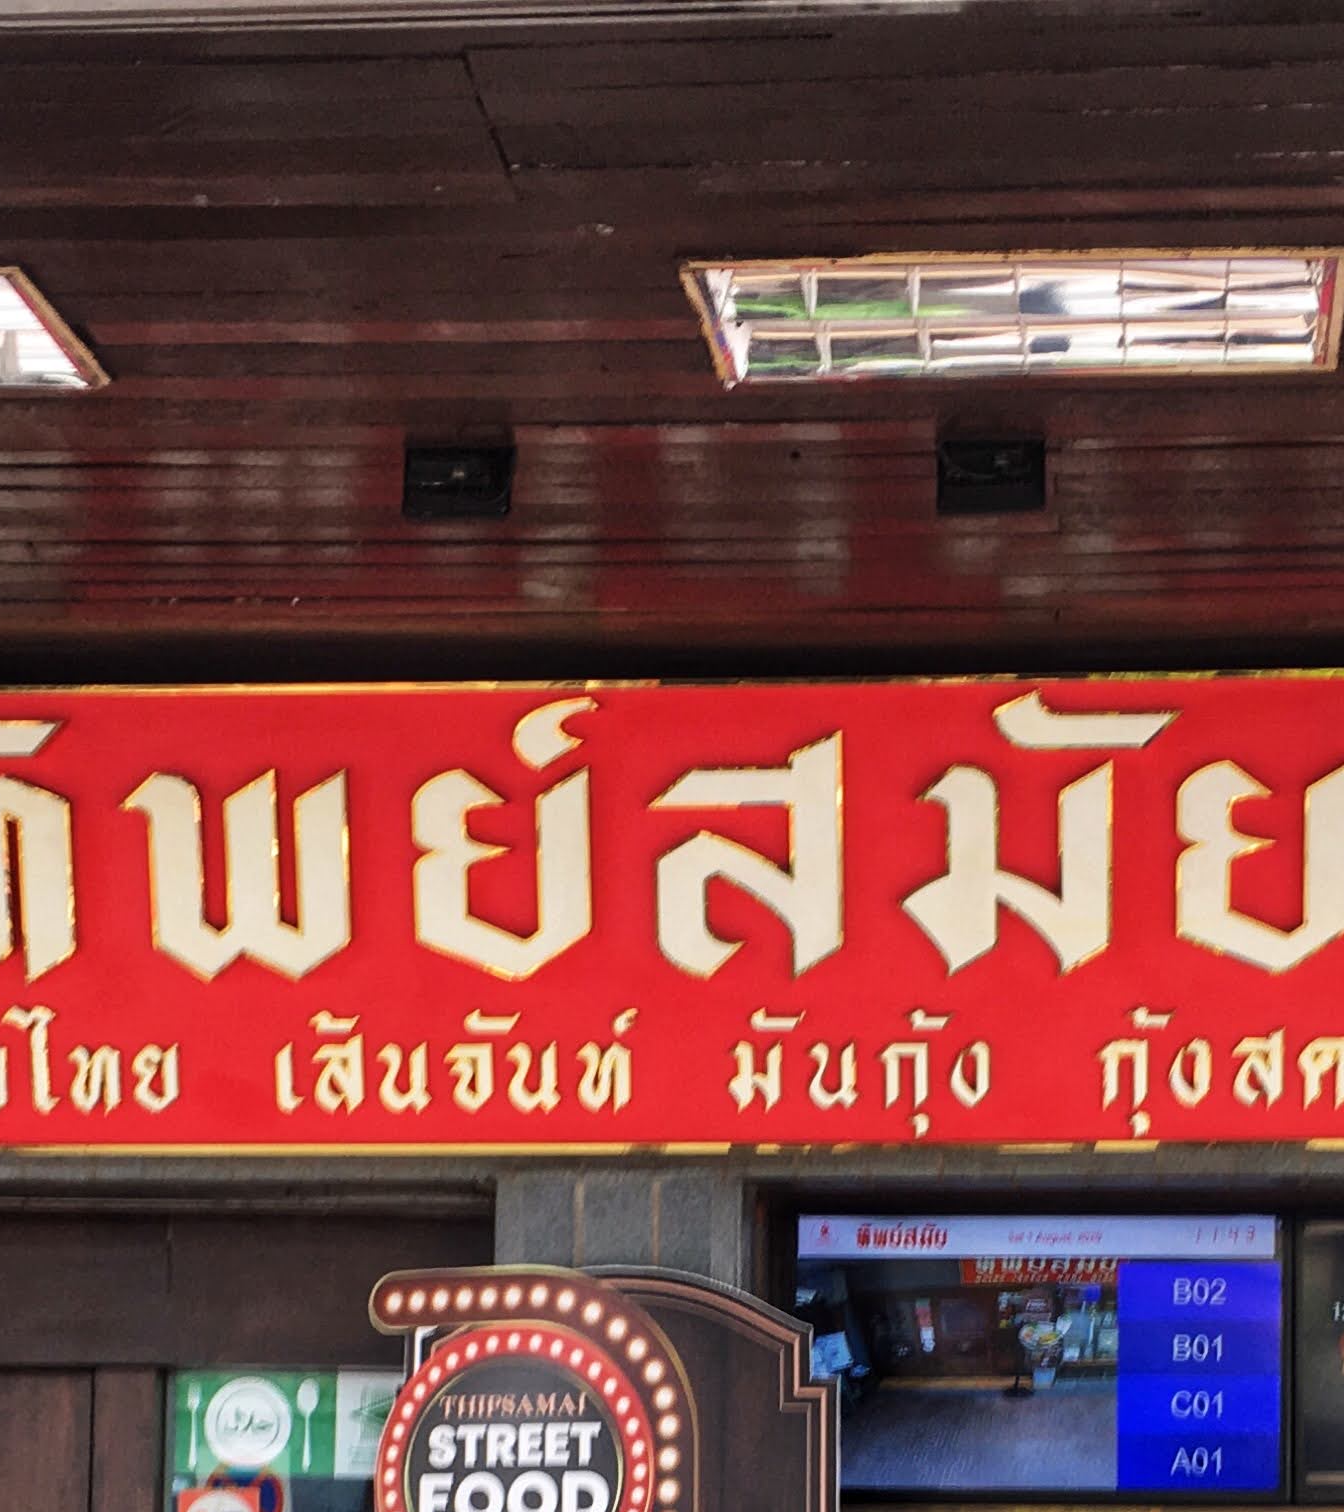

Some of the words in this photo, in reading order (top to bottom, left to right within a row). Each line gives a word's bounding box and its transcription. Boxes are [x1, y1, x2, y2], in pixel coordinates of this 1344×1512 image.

[726, 1005, 991, 1137] มันกุ้ง
[1172, 1278, 1227, 1306] B02
[1172, 1334, 1224, 1362] B01
[438, 1391, 588, 1419] THIPSAMAI
[1170, 1390, 1224, 1419] C01
[428, 1422, 602, 1469] STREET
[1170, 1447, 1224, 1477] A01
